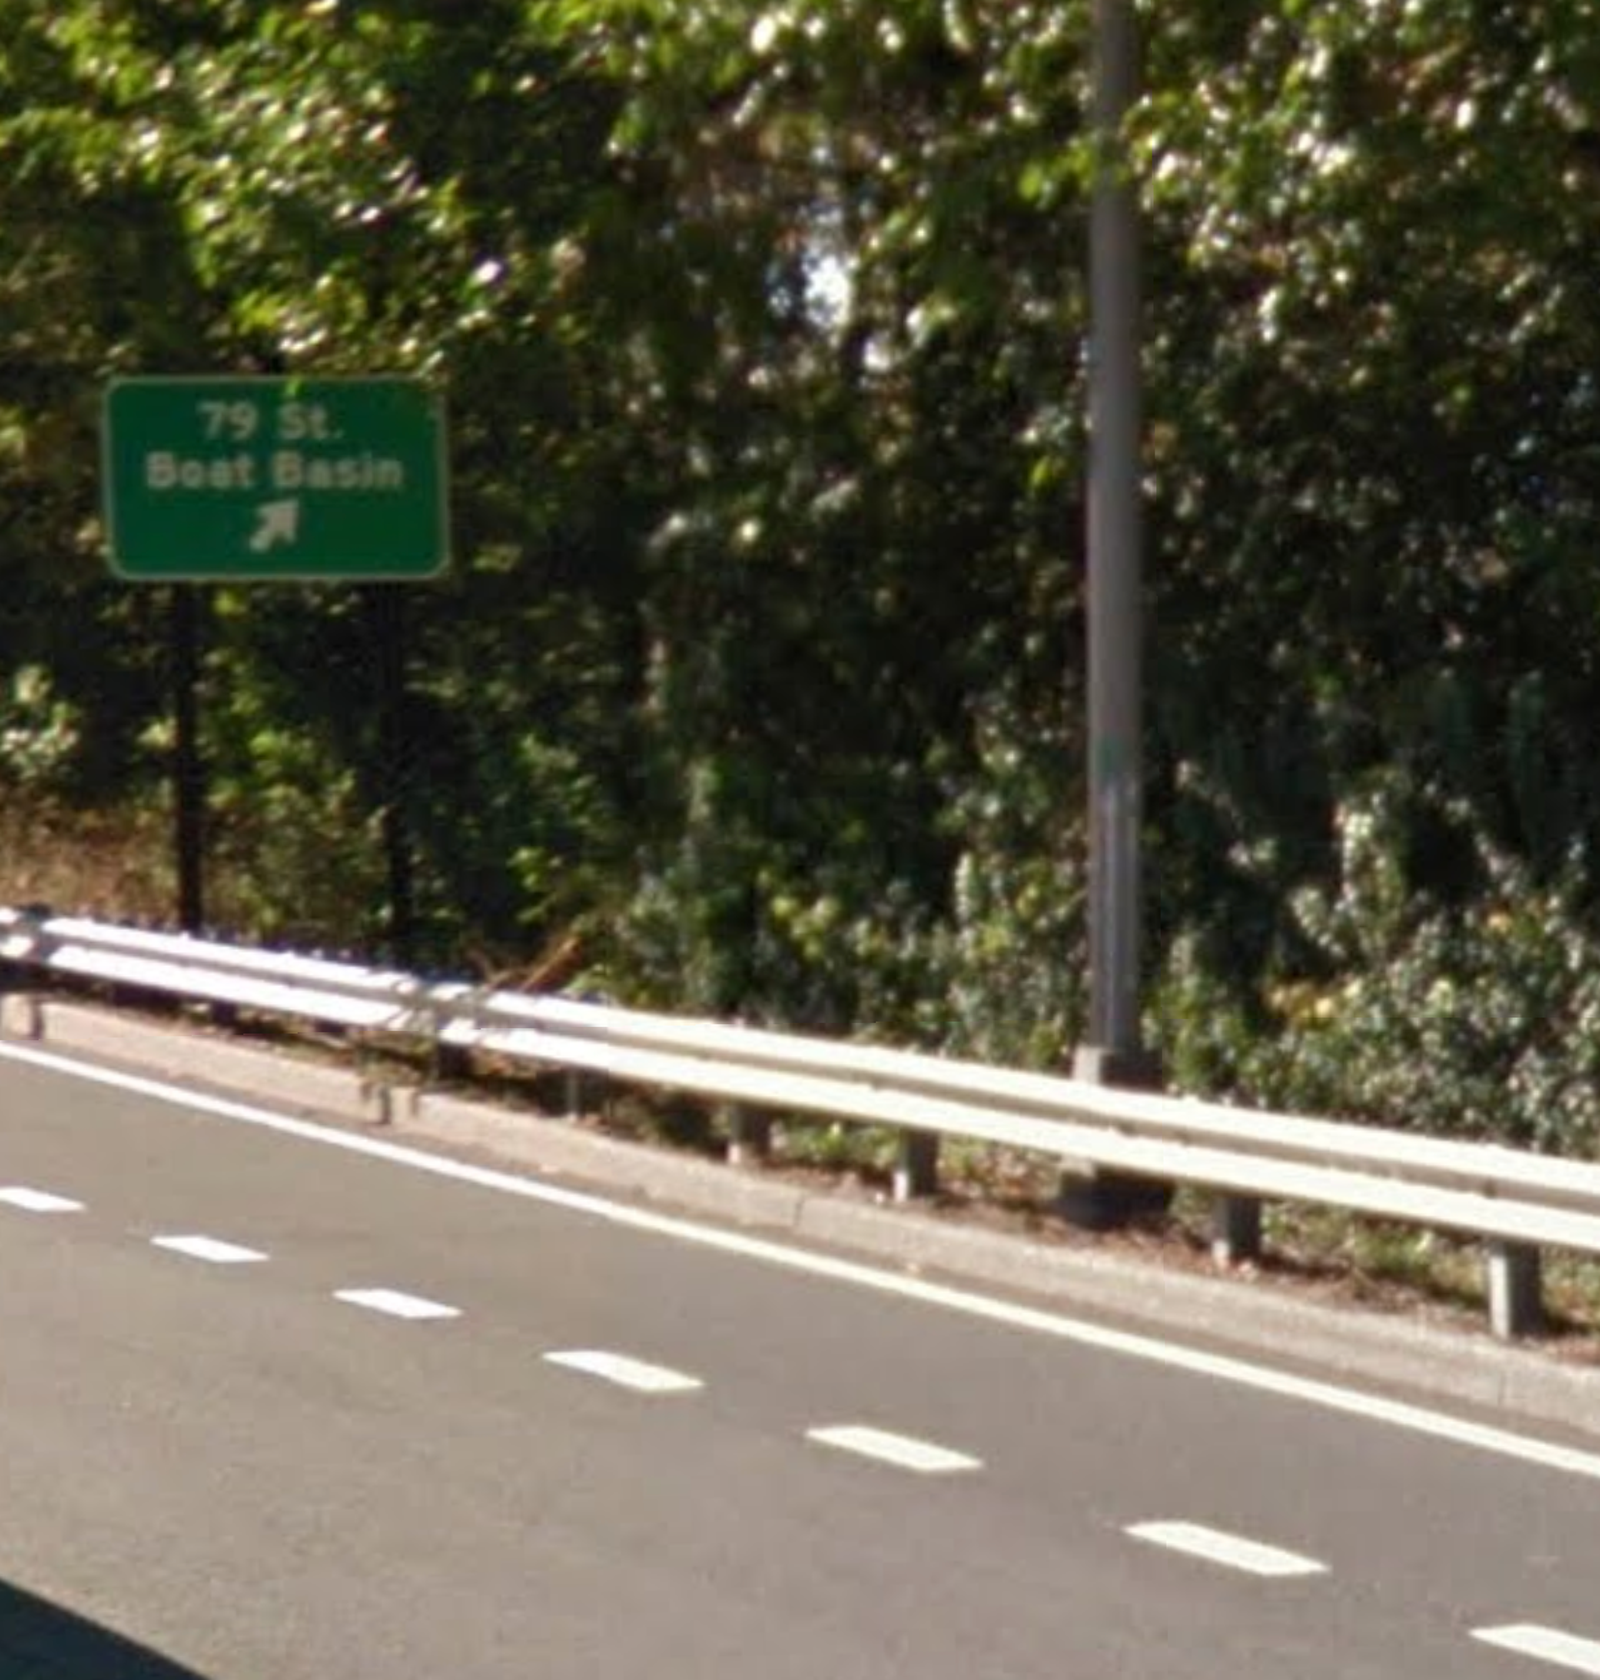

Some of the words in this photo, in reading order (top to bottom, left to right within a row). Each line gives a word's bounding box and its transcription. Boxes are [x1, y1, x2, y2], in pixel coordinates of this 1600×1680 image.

[197, 400, 257, 440] 79
[277, 401, 346, 440] St.
[147, 451, 255, 489] Boat
[272, 452, 405, 489] Basin
